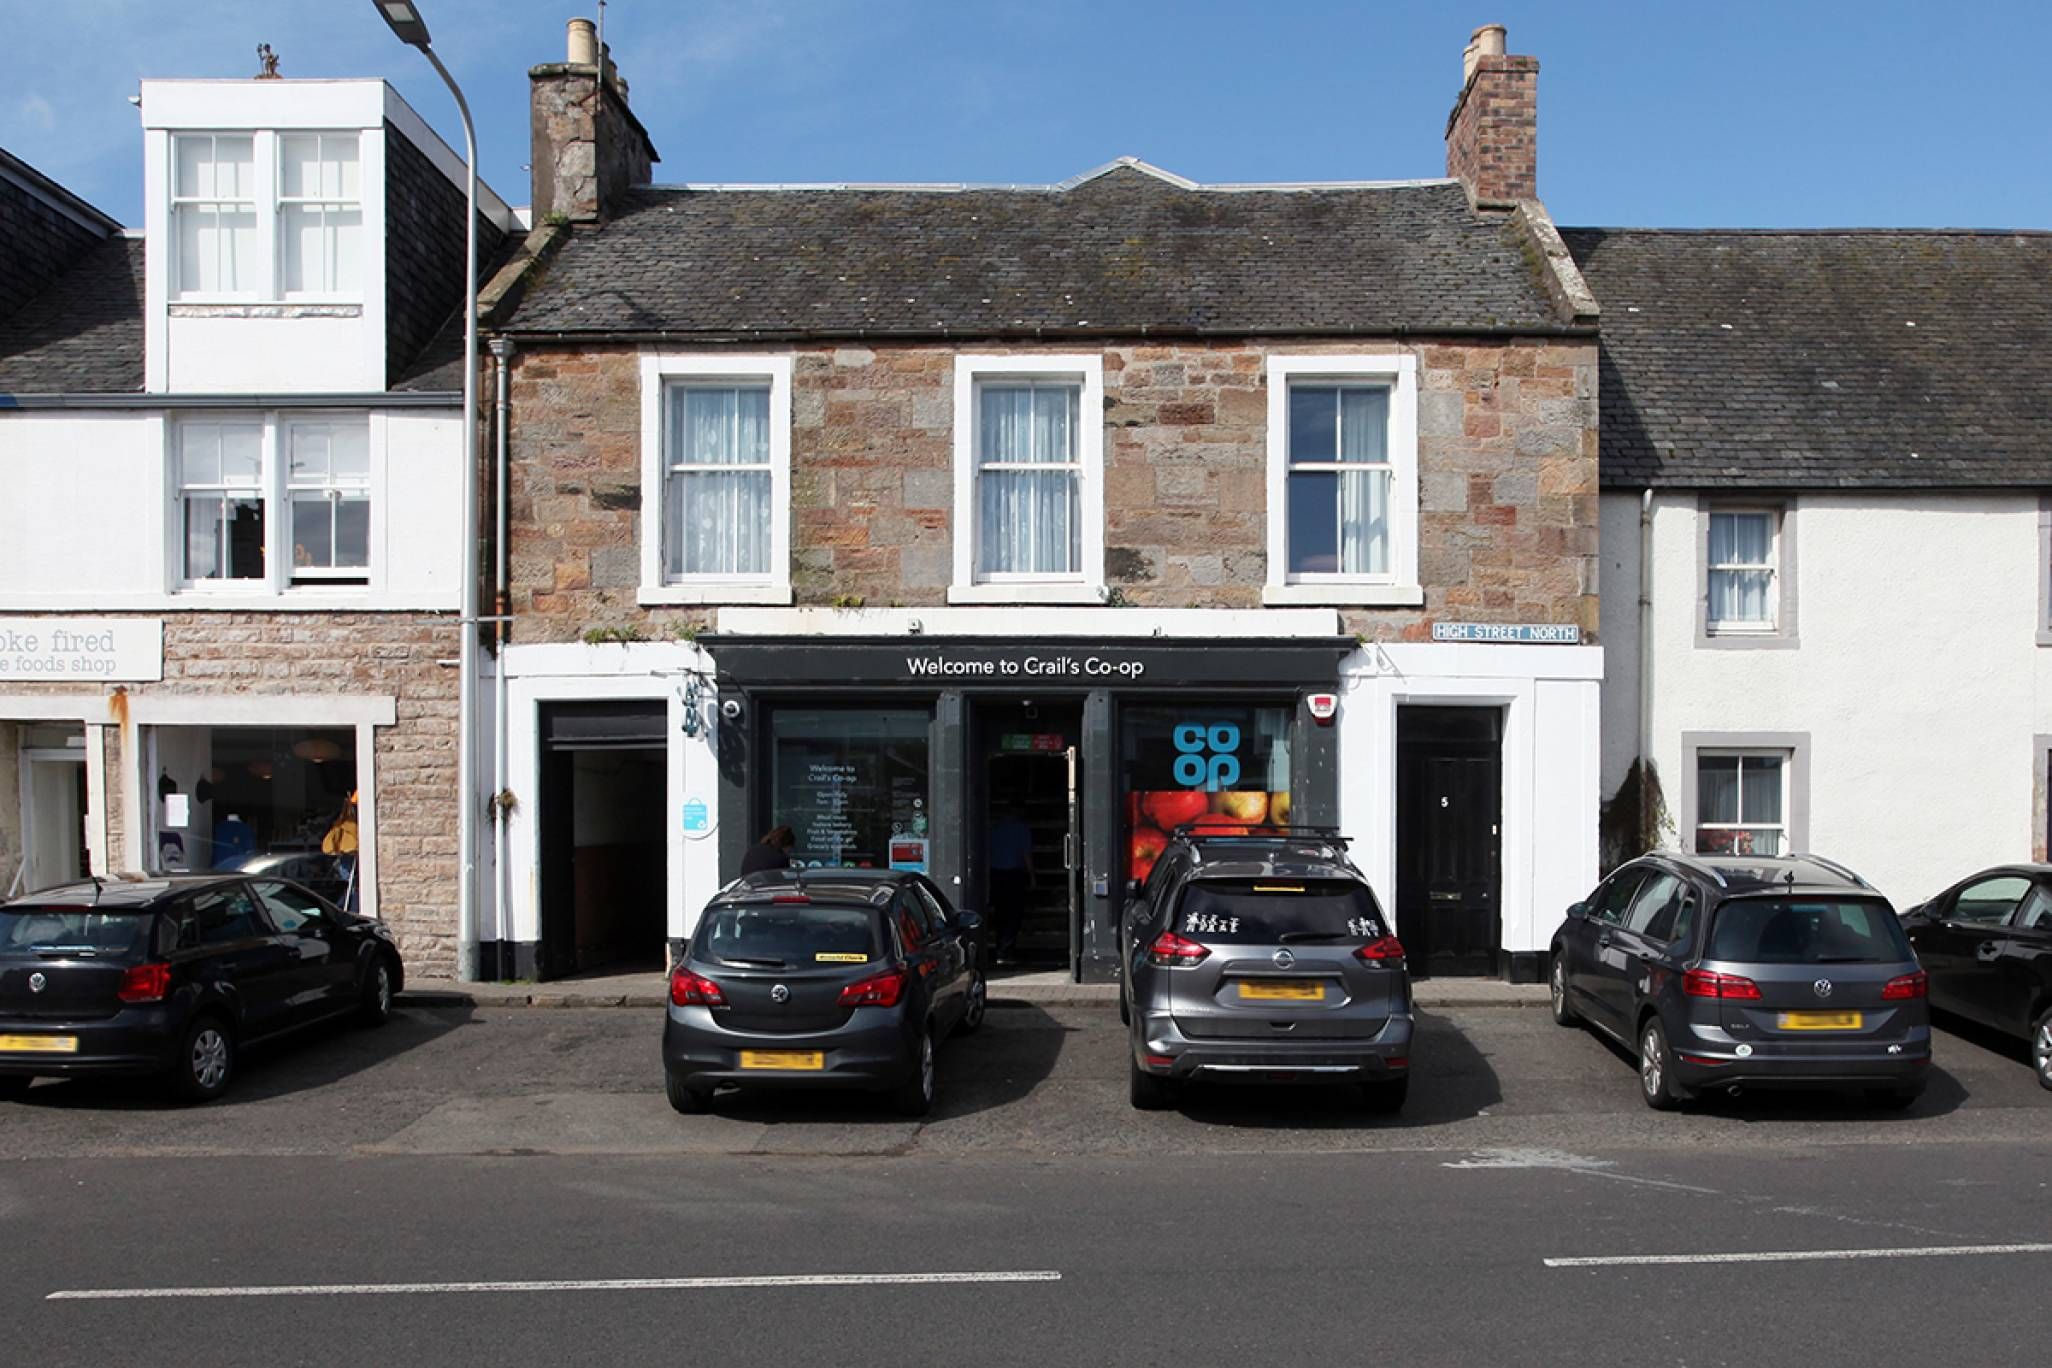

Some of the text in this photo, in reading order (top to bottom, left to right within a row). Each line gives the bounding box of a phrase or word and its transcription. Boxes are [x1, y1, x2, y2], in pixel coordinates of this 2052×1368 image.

[51, 629, 116, 652] fired
[1436, 625, 1575, 640] HIGH STREET NORTH
[16, 656, 65, 672] foods
[72, 656, 116, 675] shop
[906, 656, 1145, 679] Welcome to Crail's Co-op
[1441, 796, 1449, 807] 5
